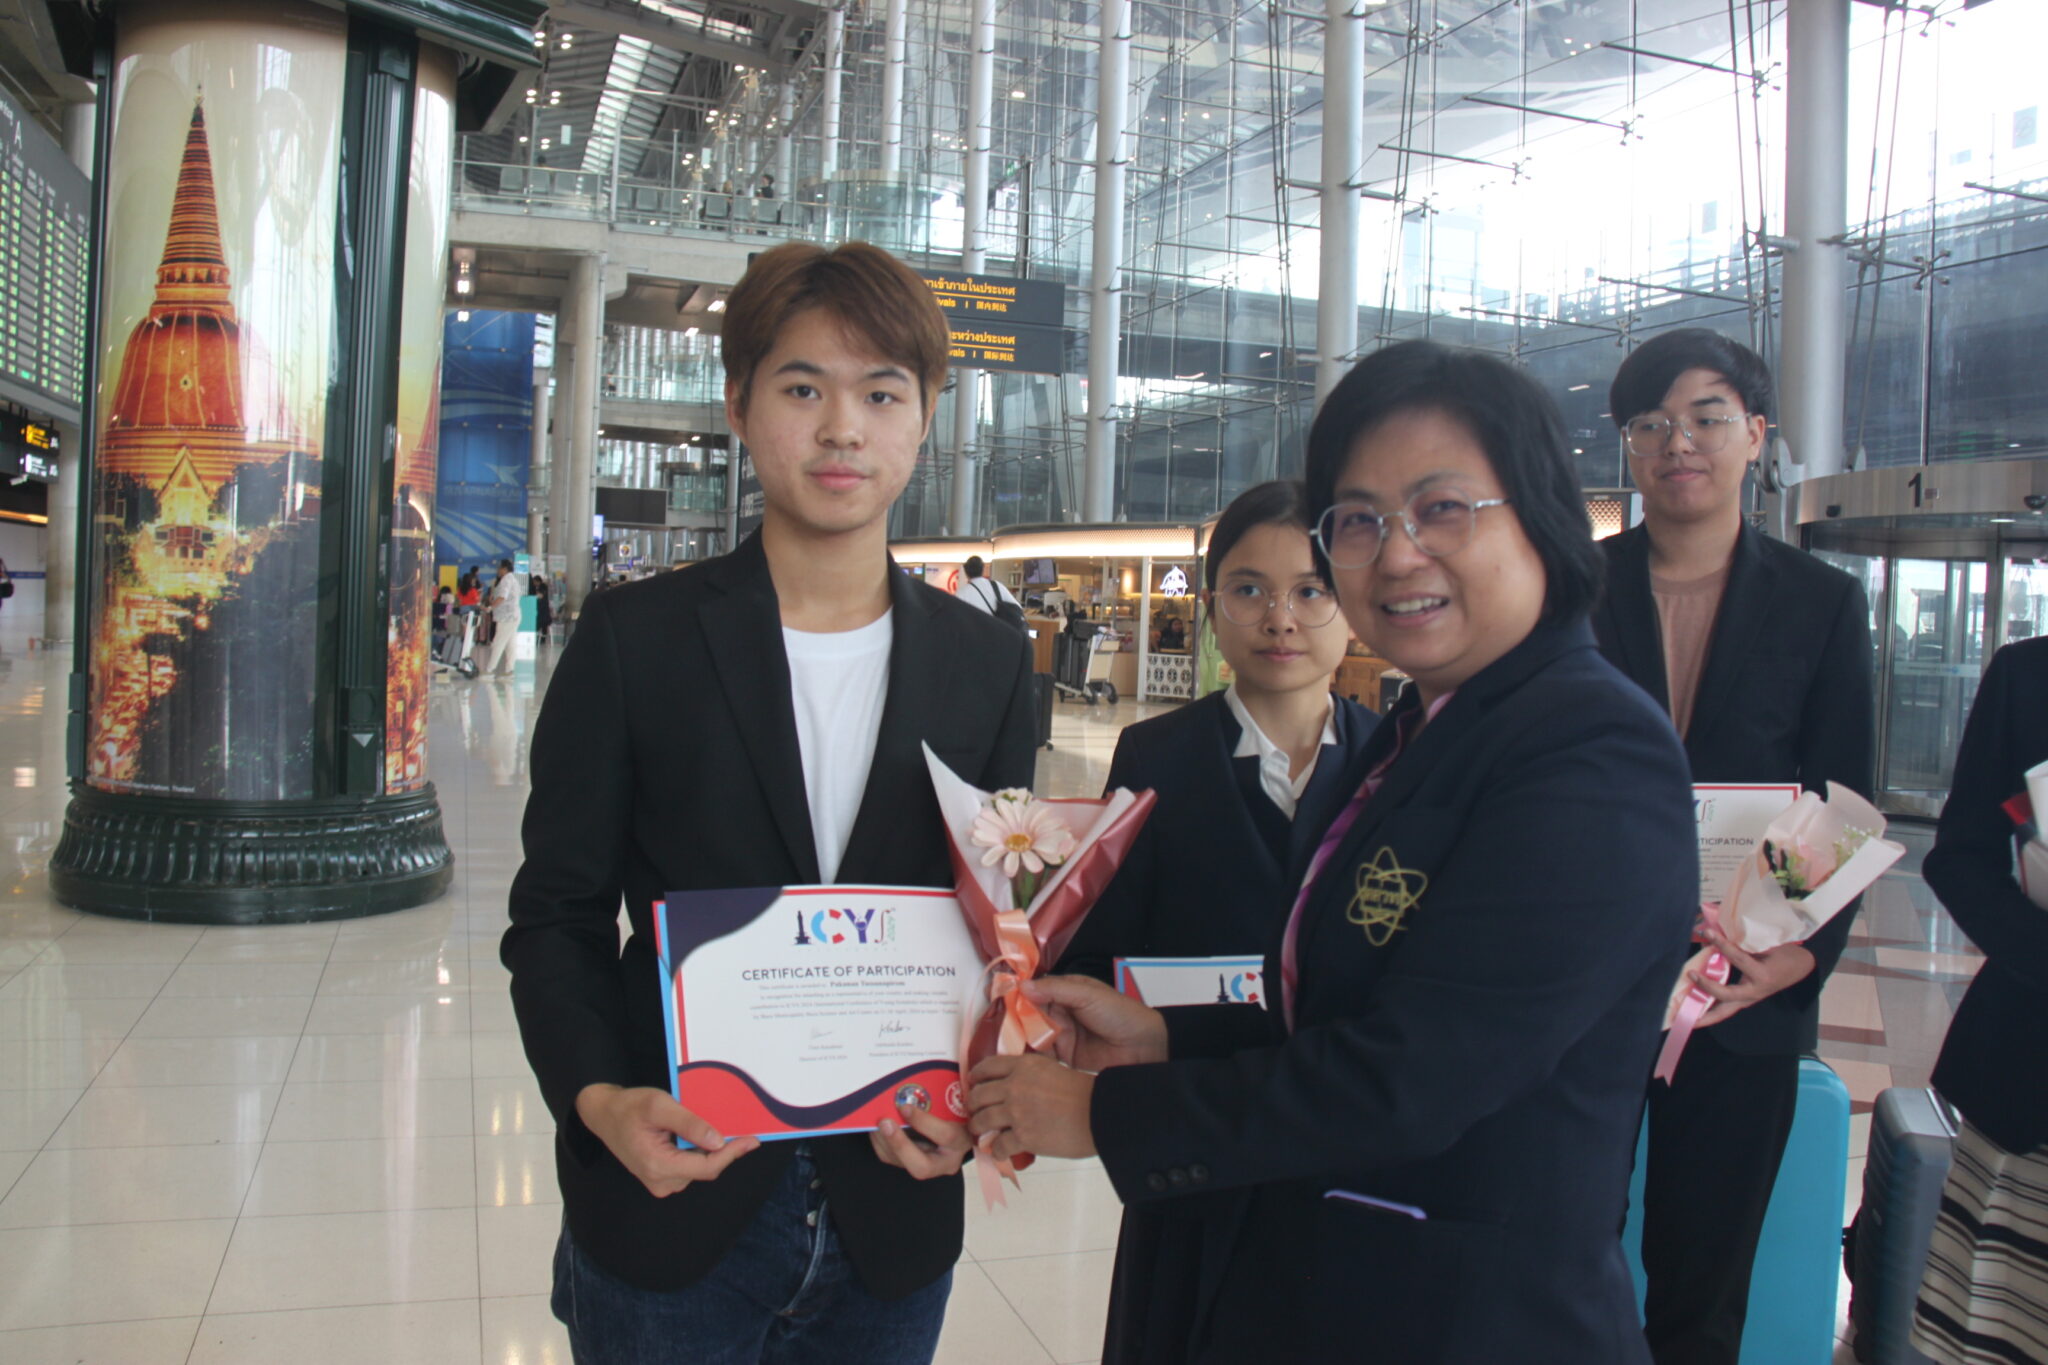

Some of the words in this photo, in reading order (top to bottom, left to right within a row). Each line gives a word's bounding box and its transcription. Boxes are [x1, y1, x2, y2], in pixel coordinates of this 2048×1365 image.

[1908, 472, 1922, 508] 1
[1699, 837, 1754, 846] TICIPATION
[742, 966, 829, 981] CERTIFICATE
[834, 965, 853, 977] OF
[857, 965, 956, 977] PARTICIPATION
